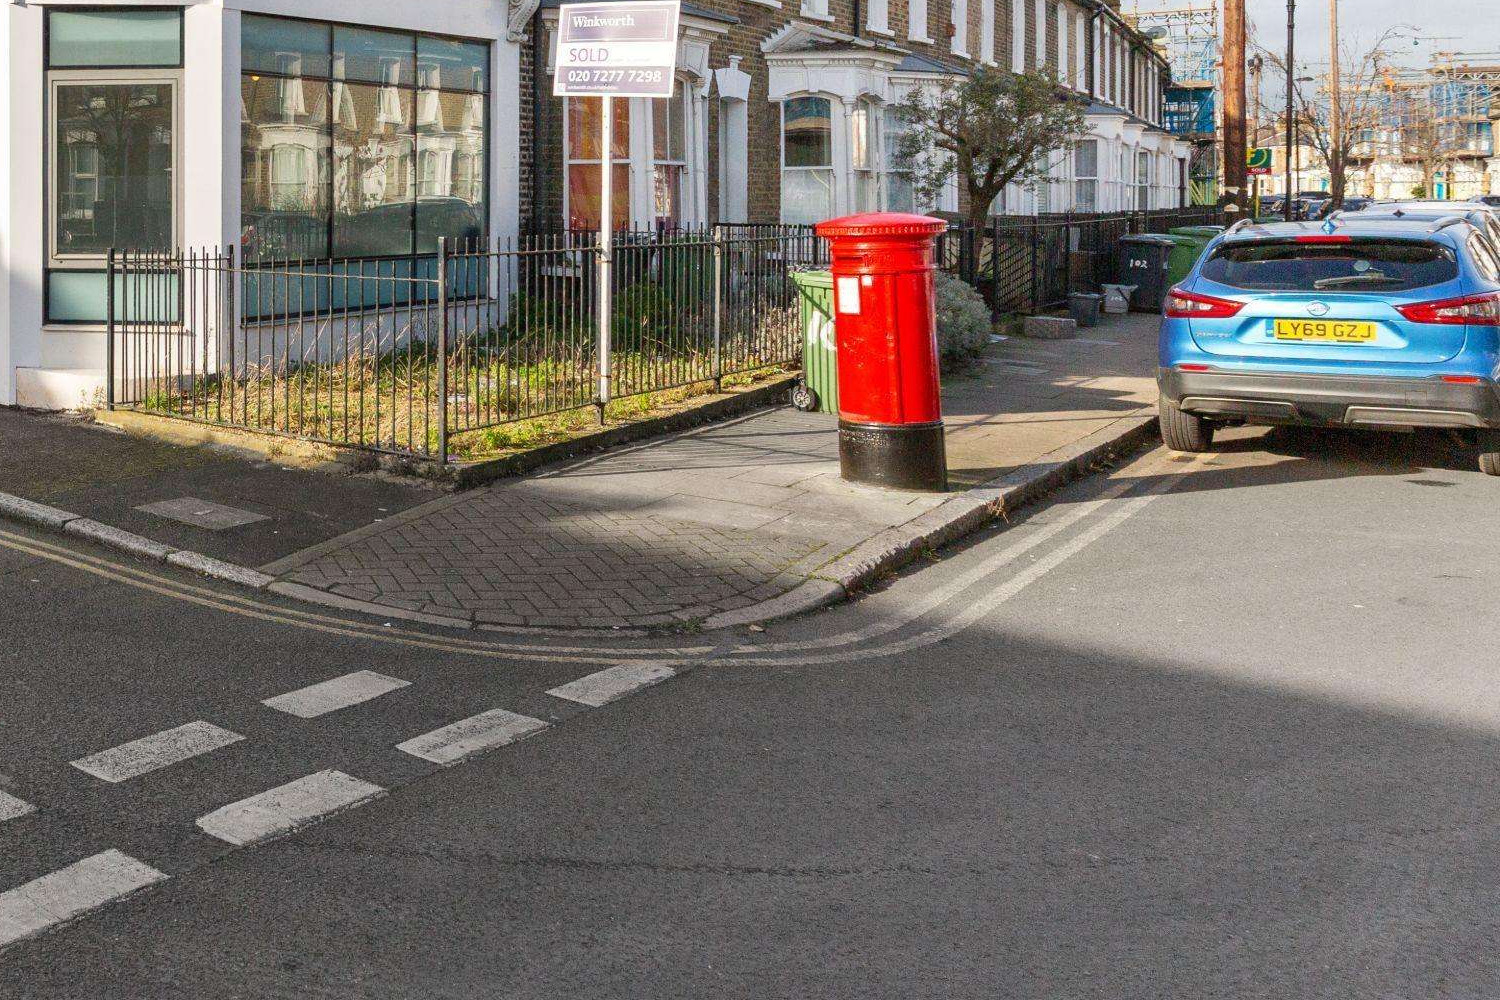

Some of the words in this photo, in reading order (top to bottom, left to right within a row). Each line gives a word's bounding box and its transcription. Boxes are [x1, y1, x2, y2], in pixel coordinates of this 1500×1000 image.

[572, 14, 635, 28] Winkworth
[569, 48, 609, 62] SOLD
[568, 70, 590, 82] 020
[592, 70, 624, 82] 7277
[628, 70, 662, 83] 7298
[1129, 258, 1148, 269] 102
[1276, 321, 1327, 337] LY69
[1332, 323, 1372, 339] GZJ
